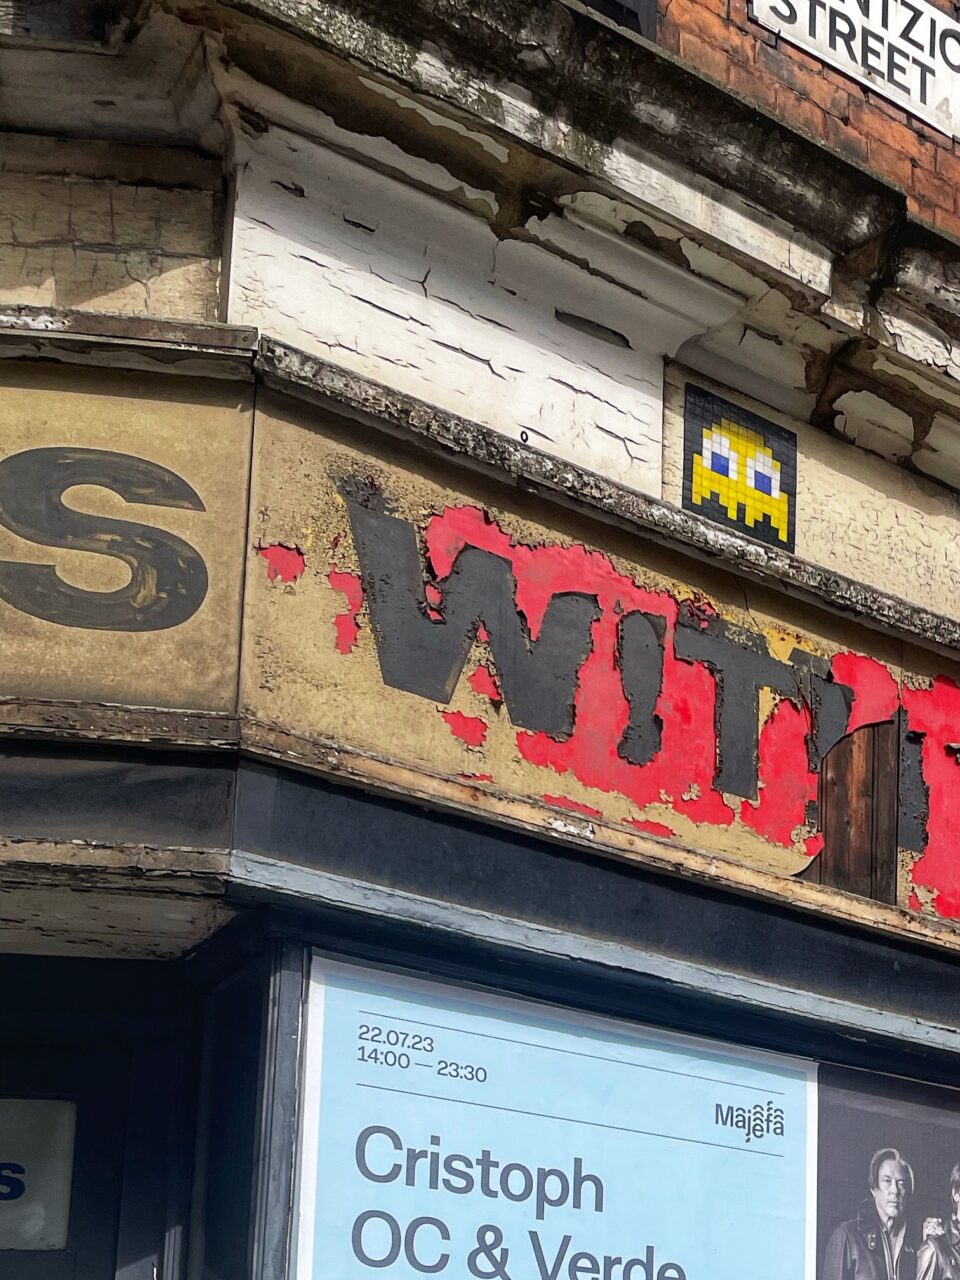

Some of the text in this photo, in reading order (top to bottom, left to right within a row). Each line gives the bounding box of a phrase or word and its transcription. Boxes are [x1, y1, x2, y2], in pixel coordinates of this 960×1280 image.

[769, 0, 936, 105] STREET
[356, 1045, 487, 1083] 14:00 23:30
[358, 1023, 435, 1053] 22.07.23
[715, 1100, 784, 1143] Majefa
[354, 1124, 604, 1220] Cristoph
[351, 1210, 451, 1274] OC
